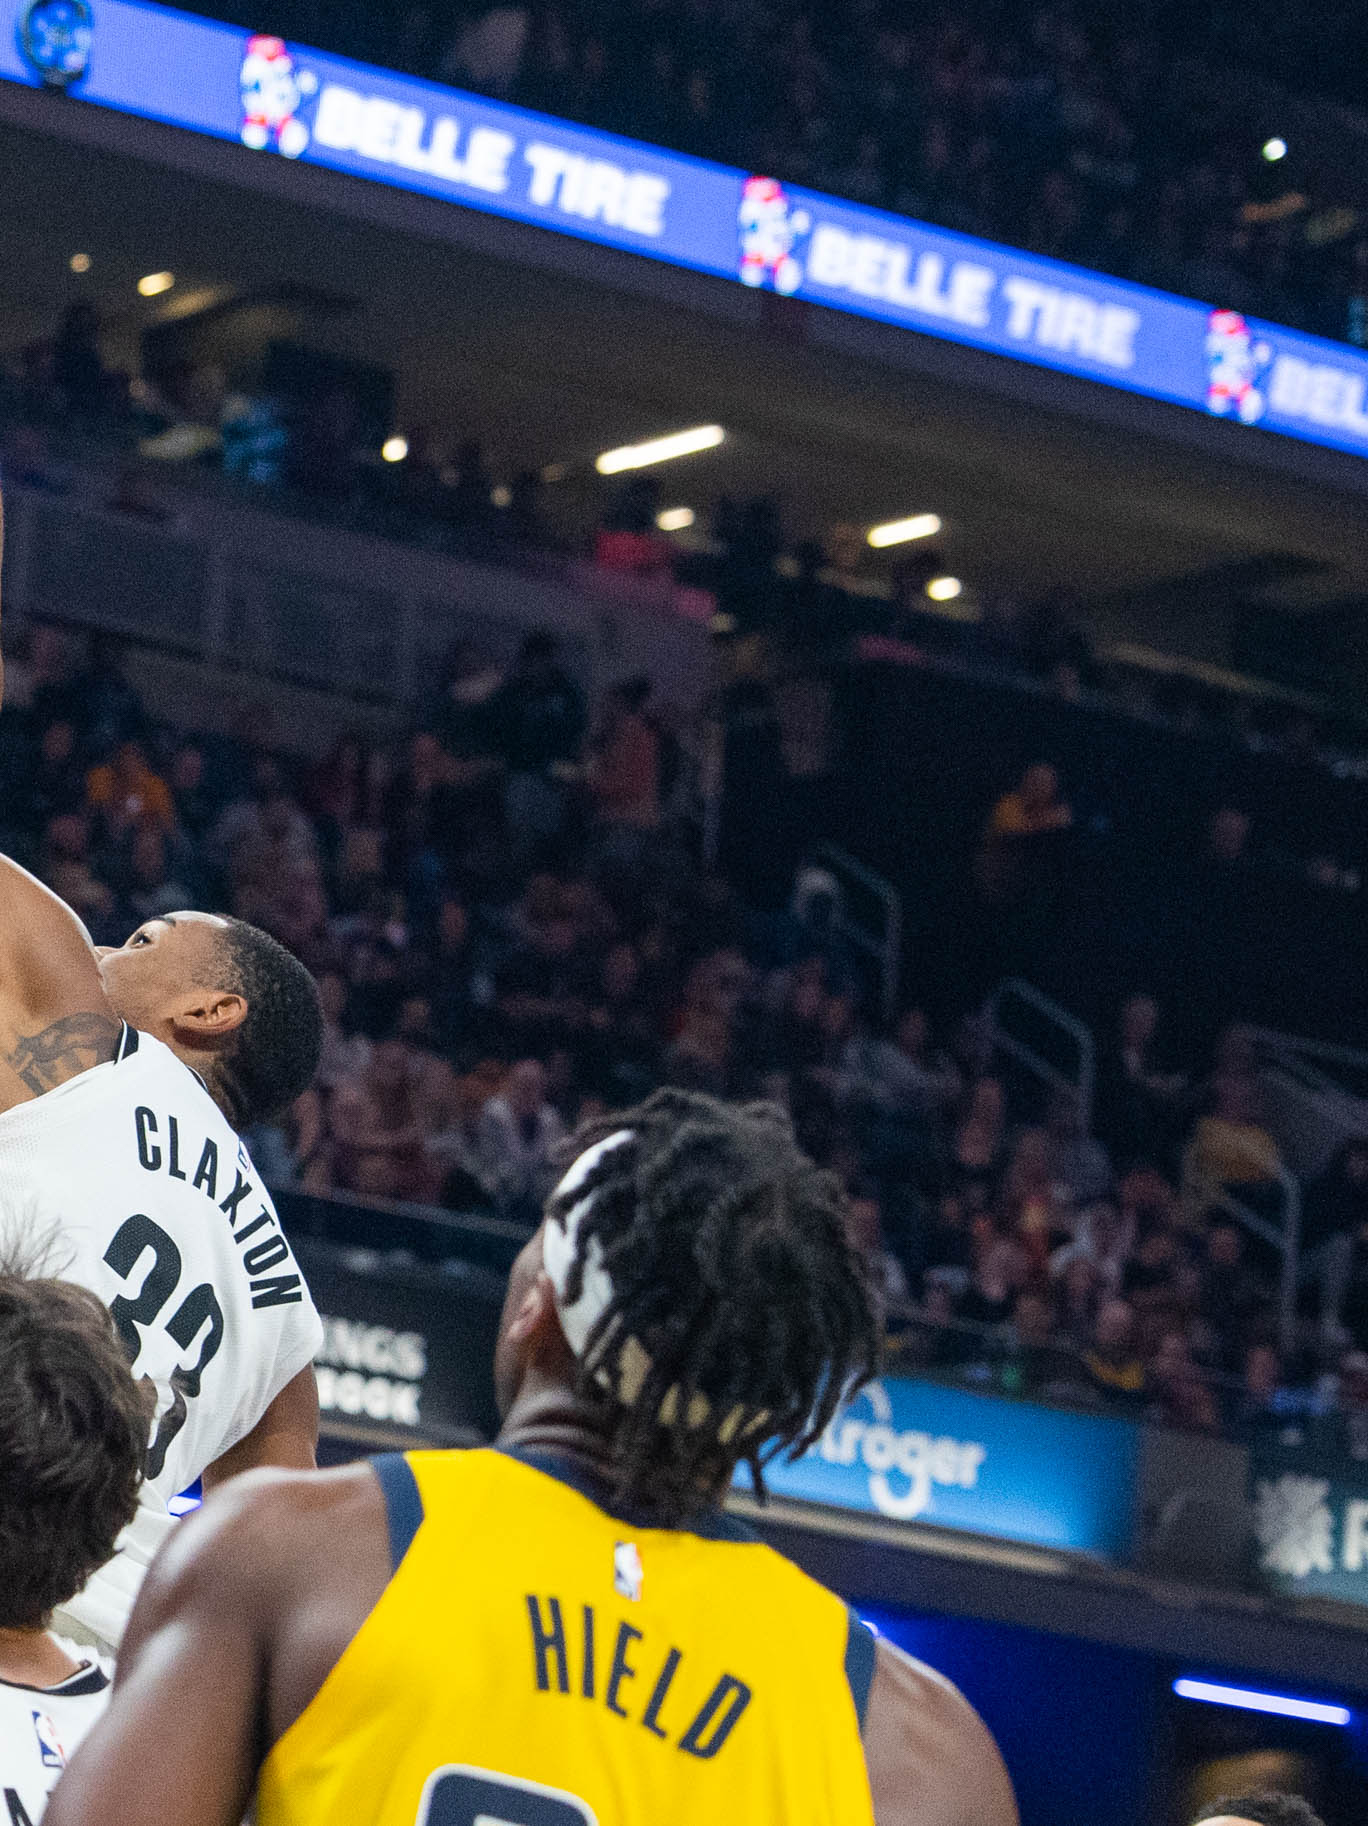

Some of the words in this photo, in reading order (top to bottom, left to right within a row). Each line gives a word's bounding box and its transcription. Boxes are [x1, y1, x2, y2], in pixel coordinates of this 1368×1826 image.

[313, 83, 514, 194] BELLE
[524, 142, 670, 237] TIRE
[807, 223, 994, 328] BELLE
[1002, 274, 1141, 370] TIRE
[134, 1105, 304, 1310] CLAXTON
[525, 1593, 753, 1760] HIELD
